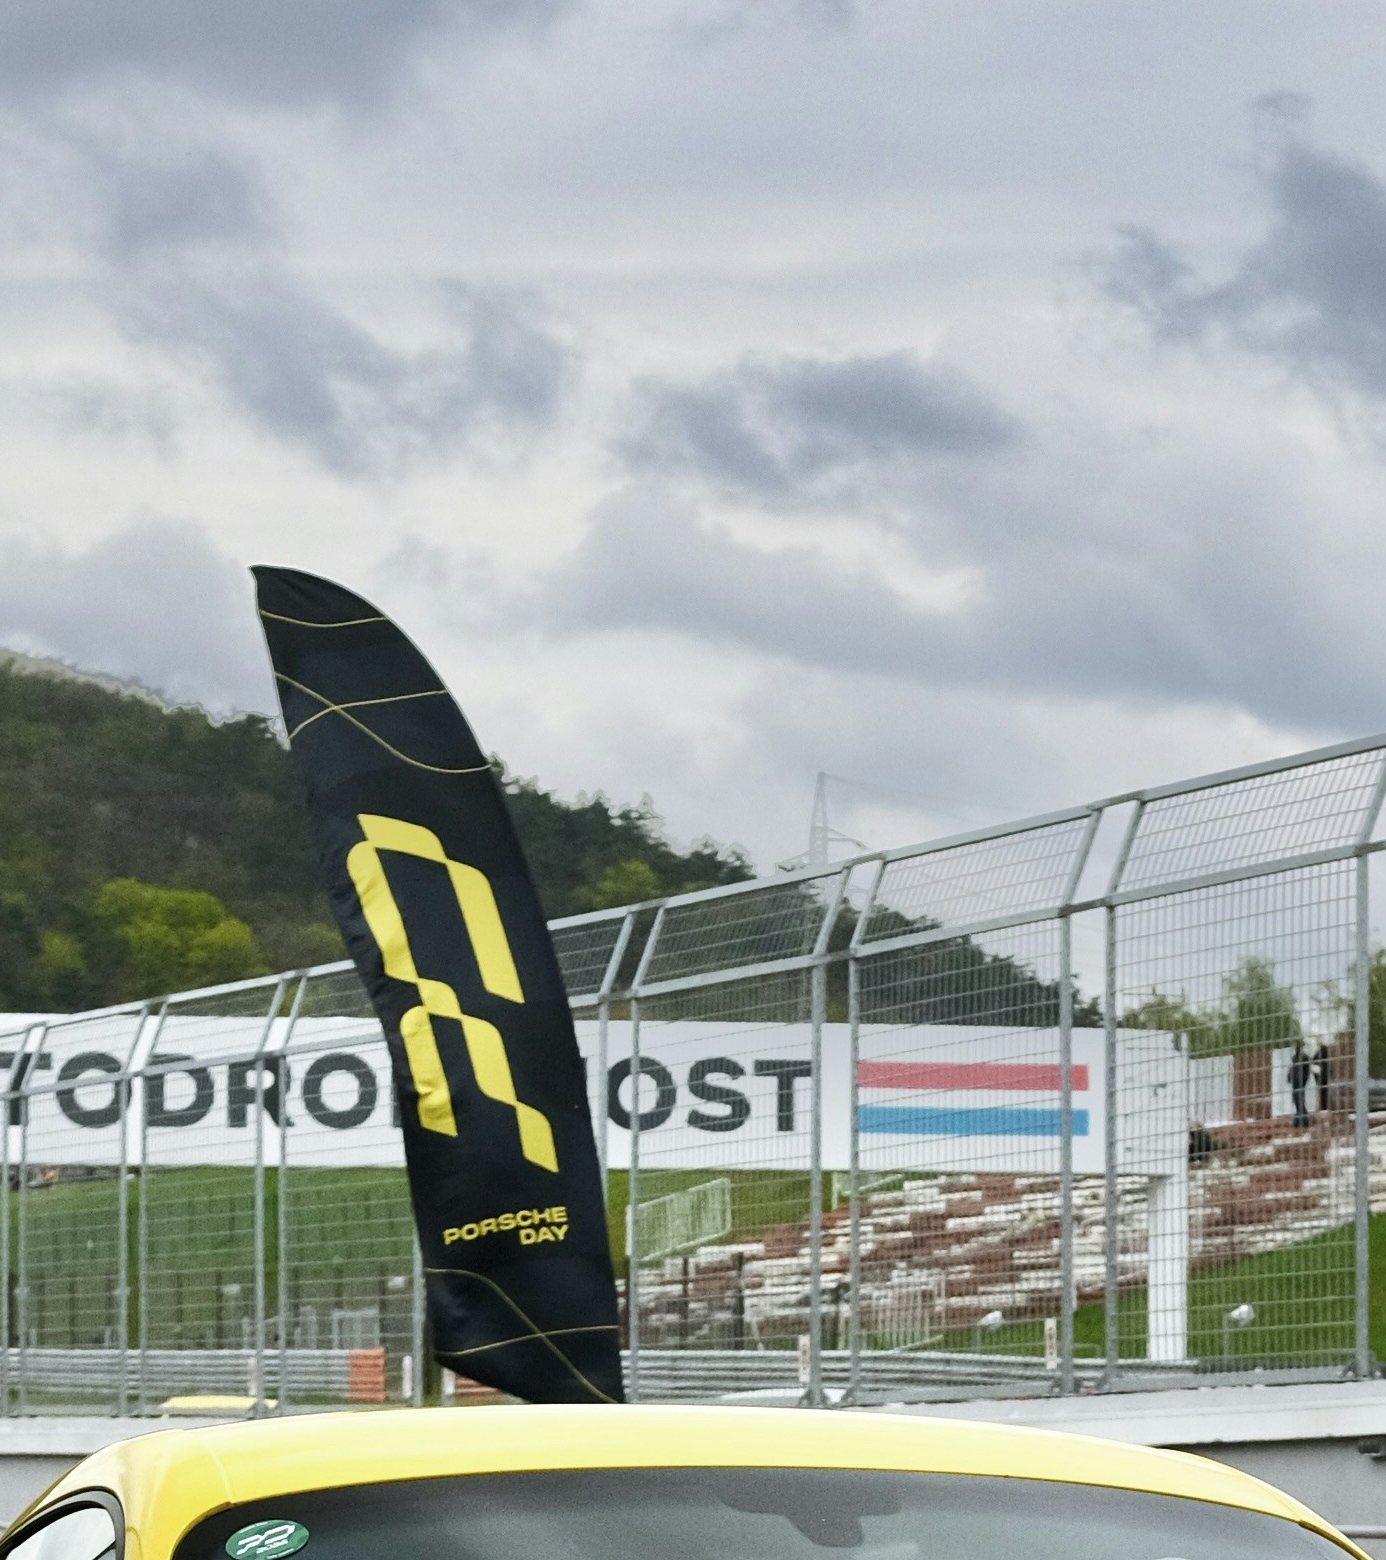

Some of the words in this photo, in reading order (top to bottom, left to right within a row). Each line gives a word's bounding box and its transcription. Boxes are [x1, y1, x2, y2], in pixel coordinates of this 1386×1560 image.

[580, 1054, 813, 1134] OST
[442, 1205, 569, 1246] PORSCHE
[518, 1224, 570, 1246] DAY
